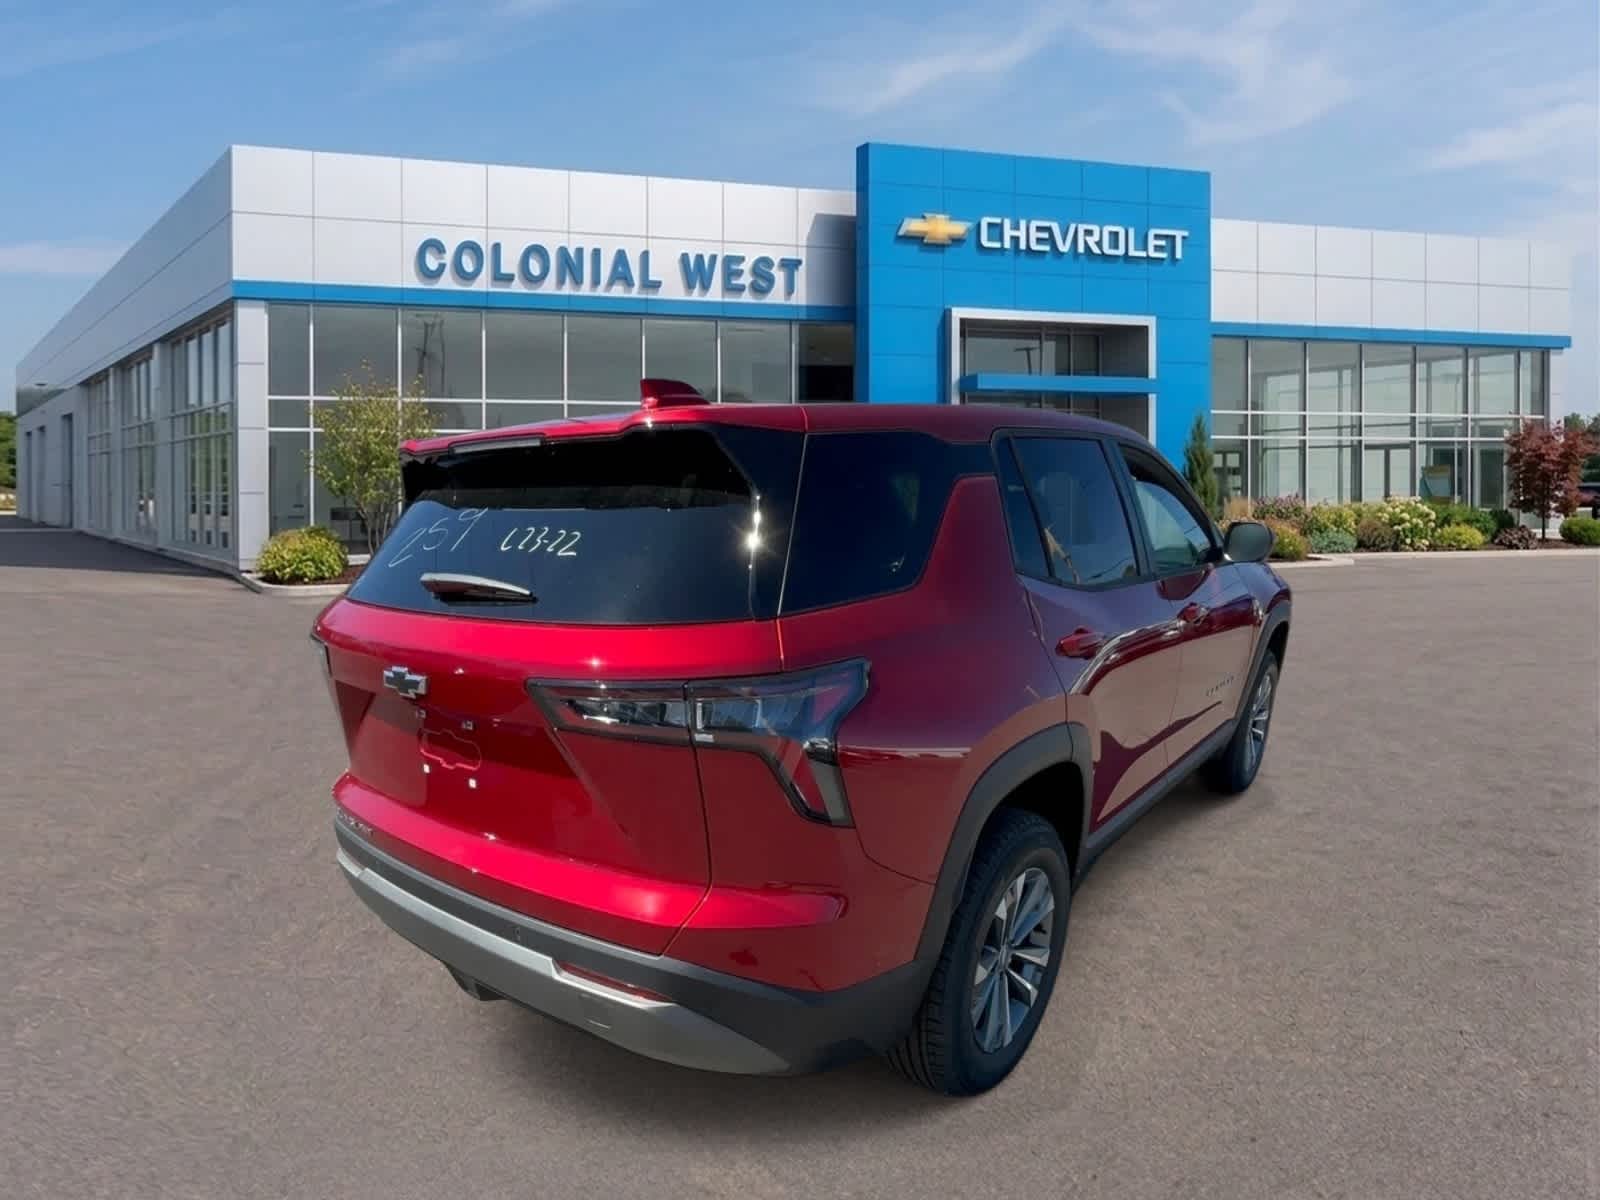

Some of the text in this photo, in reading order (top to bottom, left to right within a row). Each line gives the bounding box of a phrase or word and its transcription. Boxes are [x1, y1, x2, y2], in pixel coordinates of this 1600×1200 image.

[980, 216, 1190, 260] CHEVROLET
[416, 238, 803, 296] COLONIAL WEST
